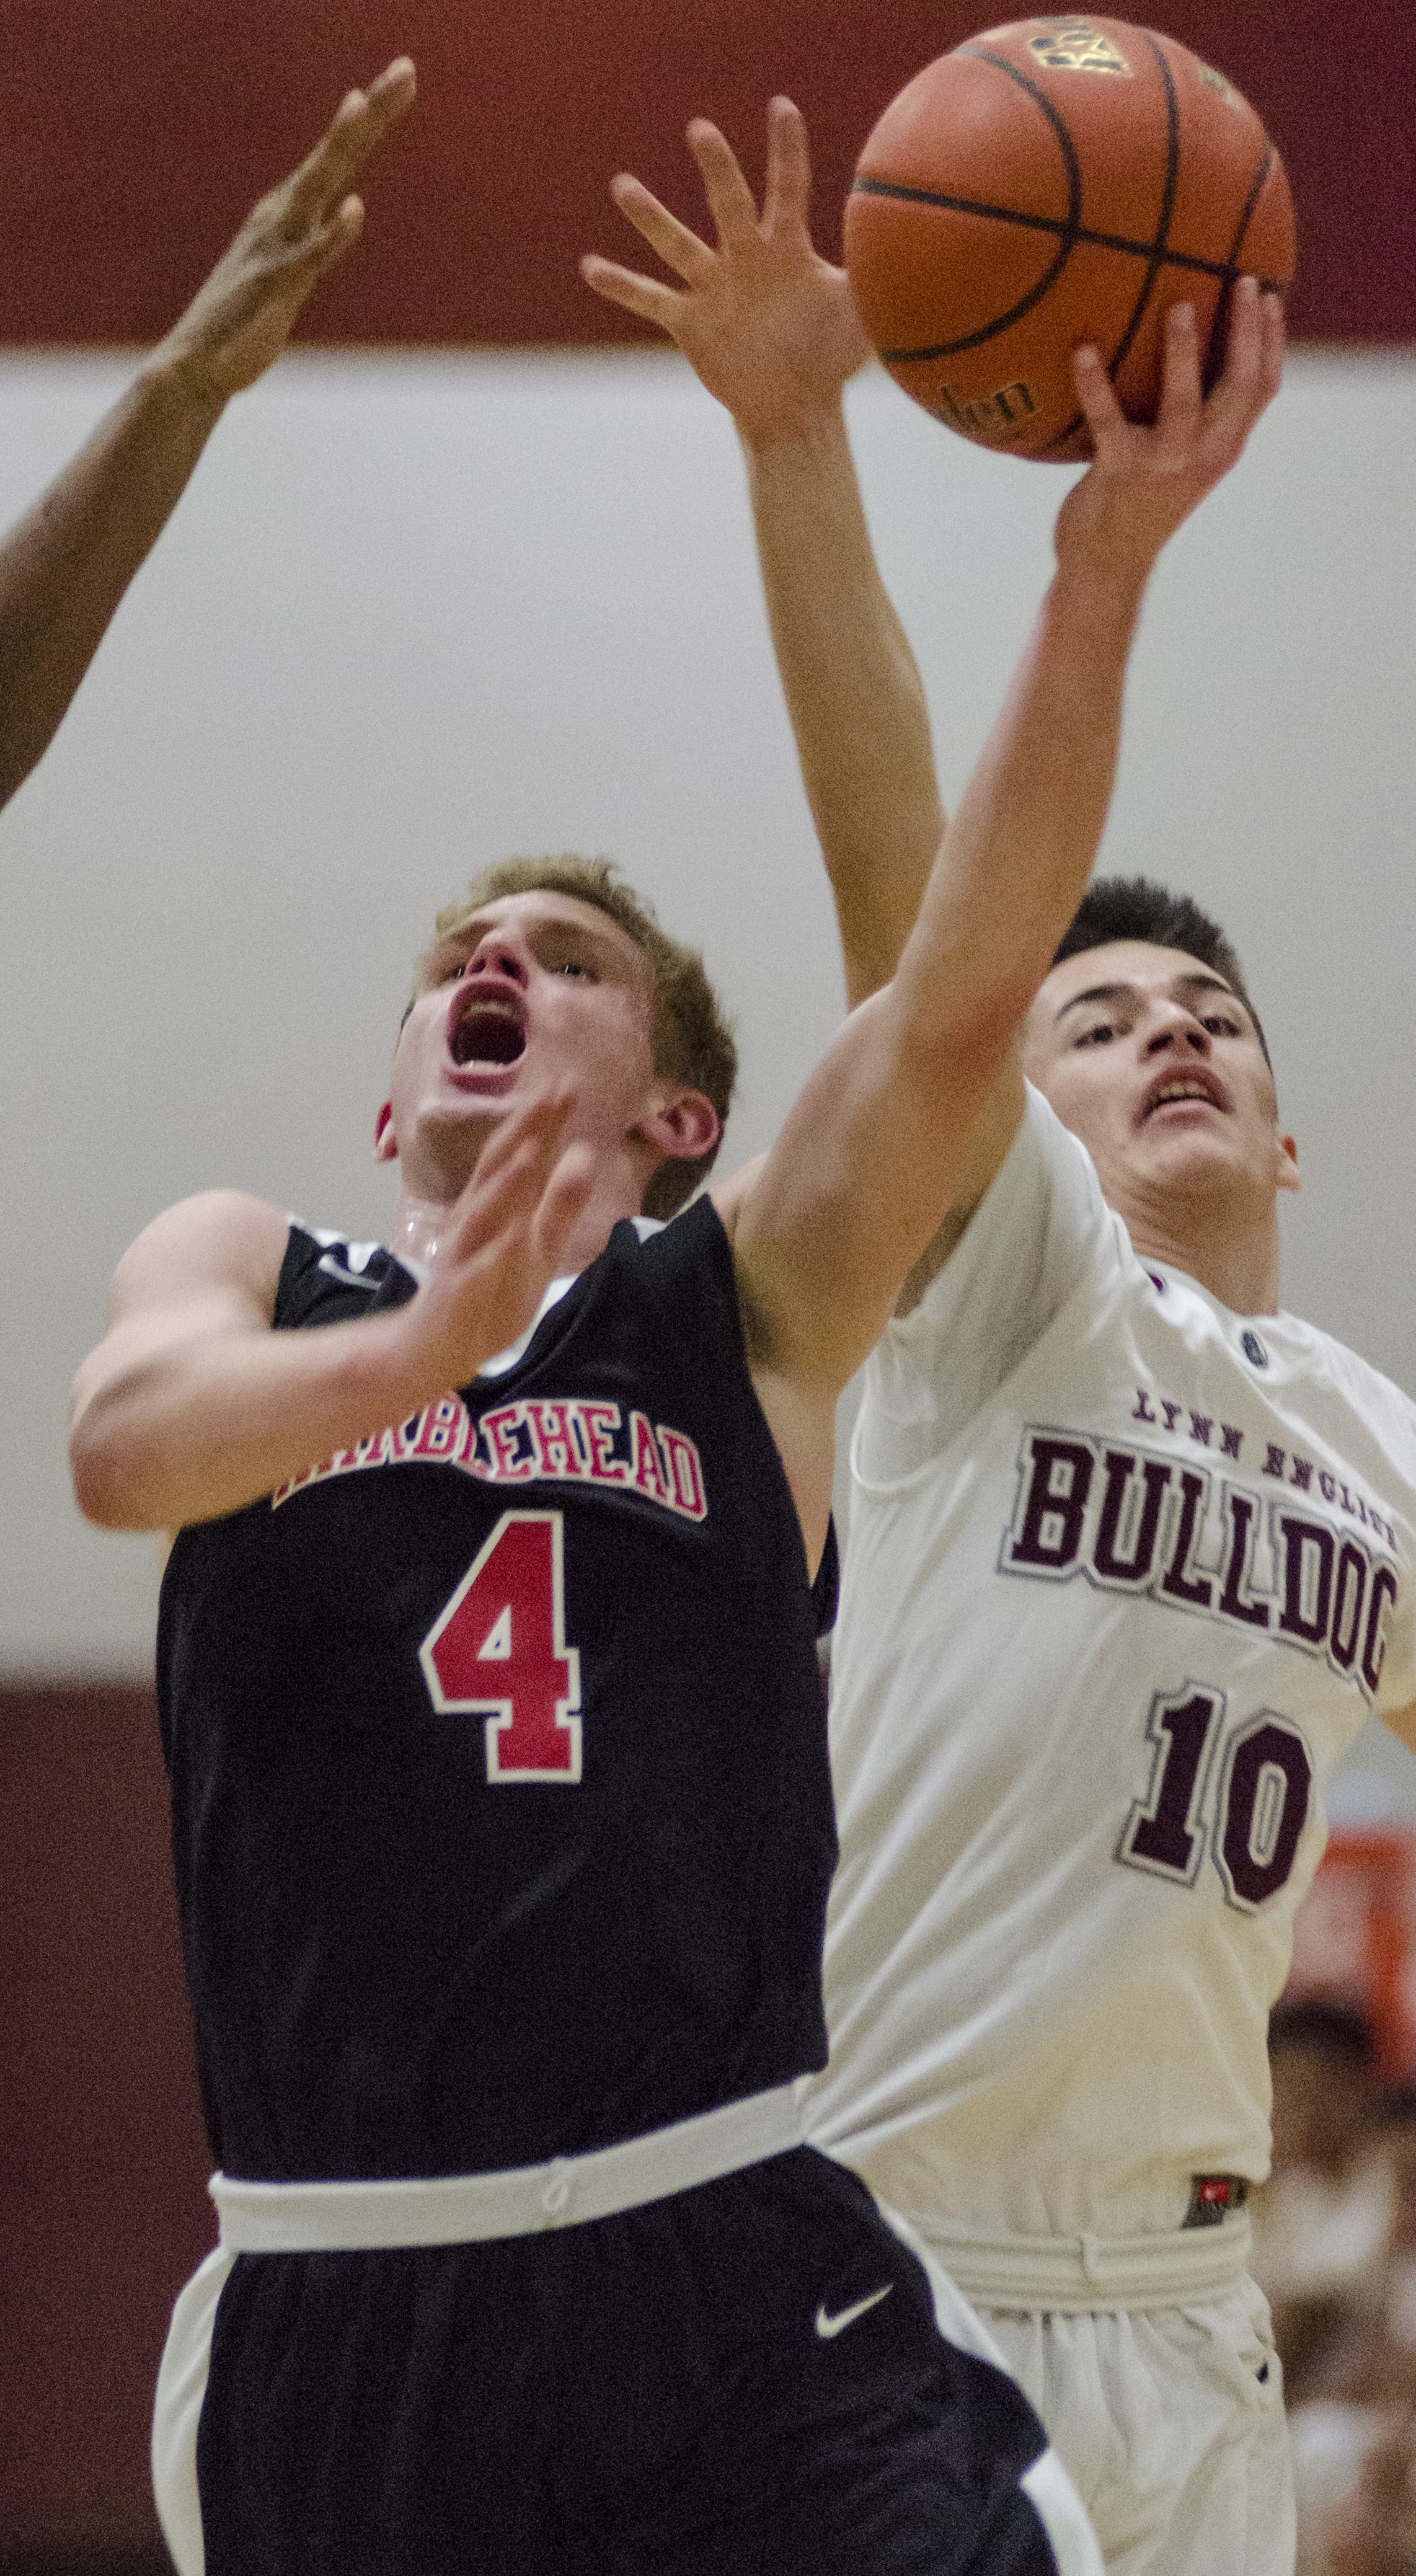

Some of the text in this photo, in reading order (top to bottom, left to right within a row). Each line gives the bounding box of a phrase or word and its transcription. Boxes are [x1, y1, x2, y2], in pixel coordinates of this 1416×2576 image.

[272, 1392, 707, 1523] BLEHEAD
[1133, 1390, 1244, 1459] LYNN
[419, 1510, 582, 1784] 4
[1117, 1678, 1314, 1916] 10
